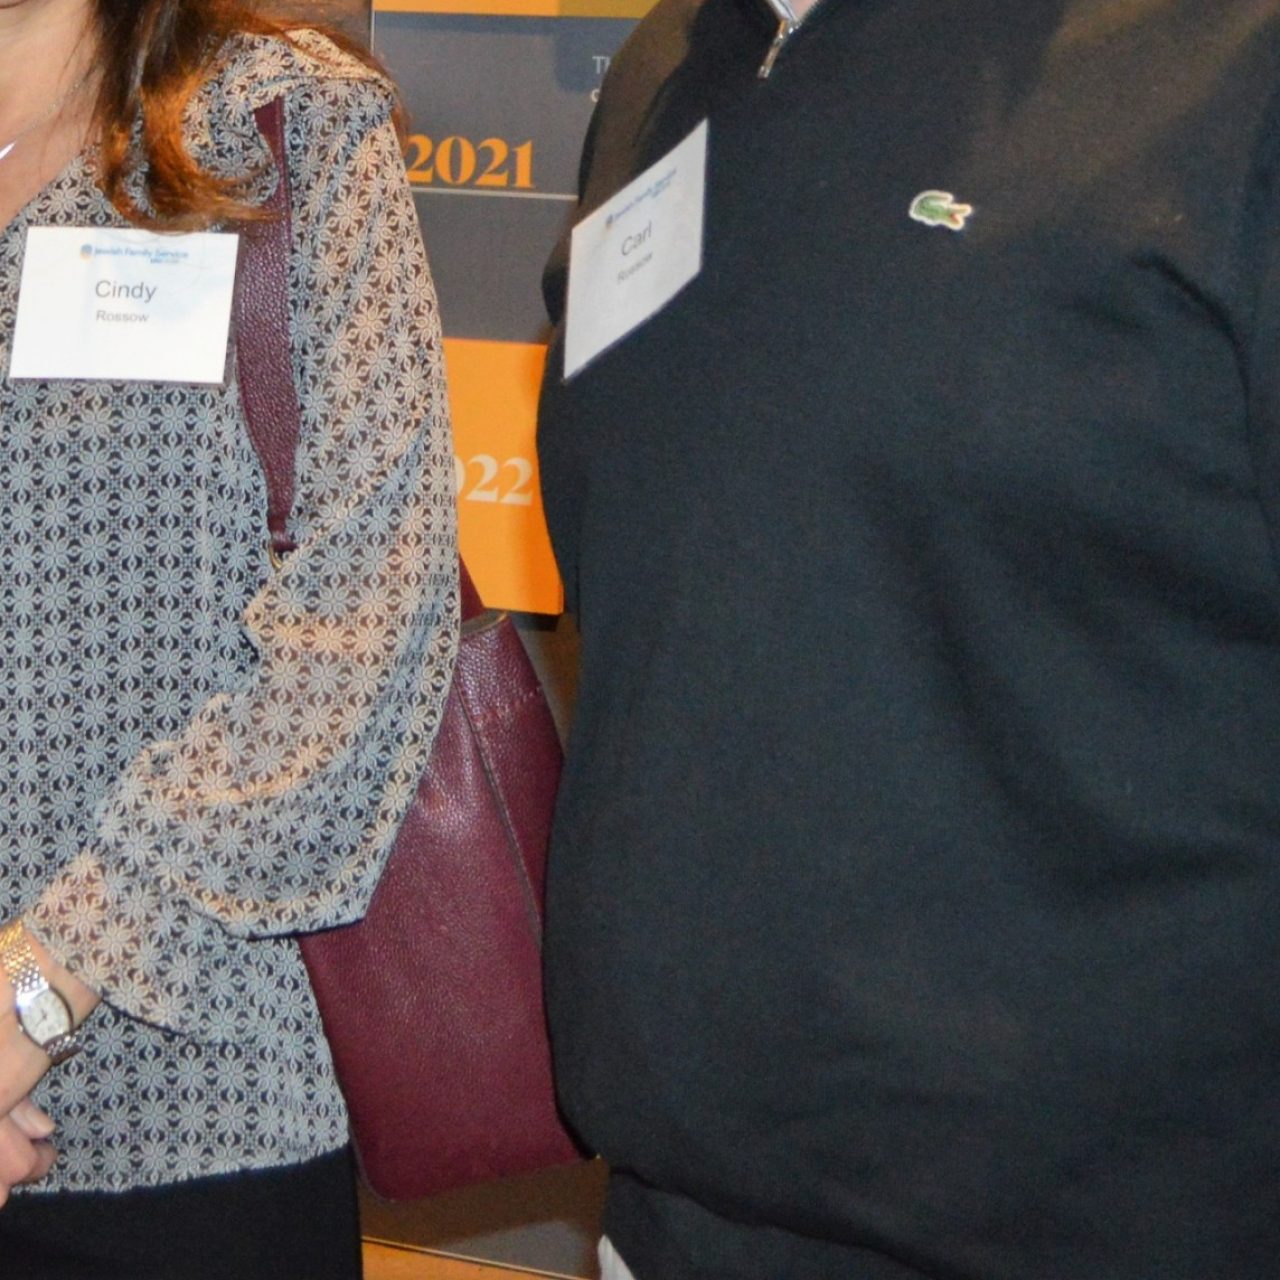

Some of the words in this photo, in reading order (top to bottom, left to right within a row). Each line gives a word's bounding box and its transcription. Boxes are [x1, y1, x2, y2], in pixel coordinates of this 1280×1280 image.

[406, 135, 535, 189] 2021
[621, 220, 652, 256] Carl
[95, 280, 157, 303] Cindy
